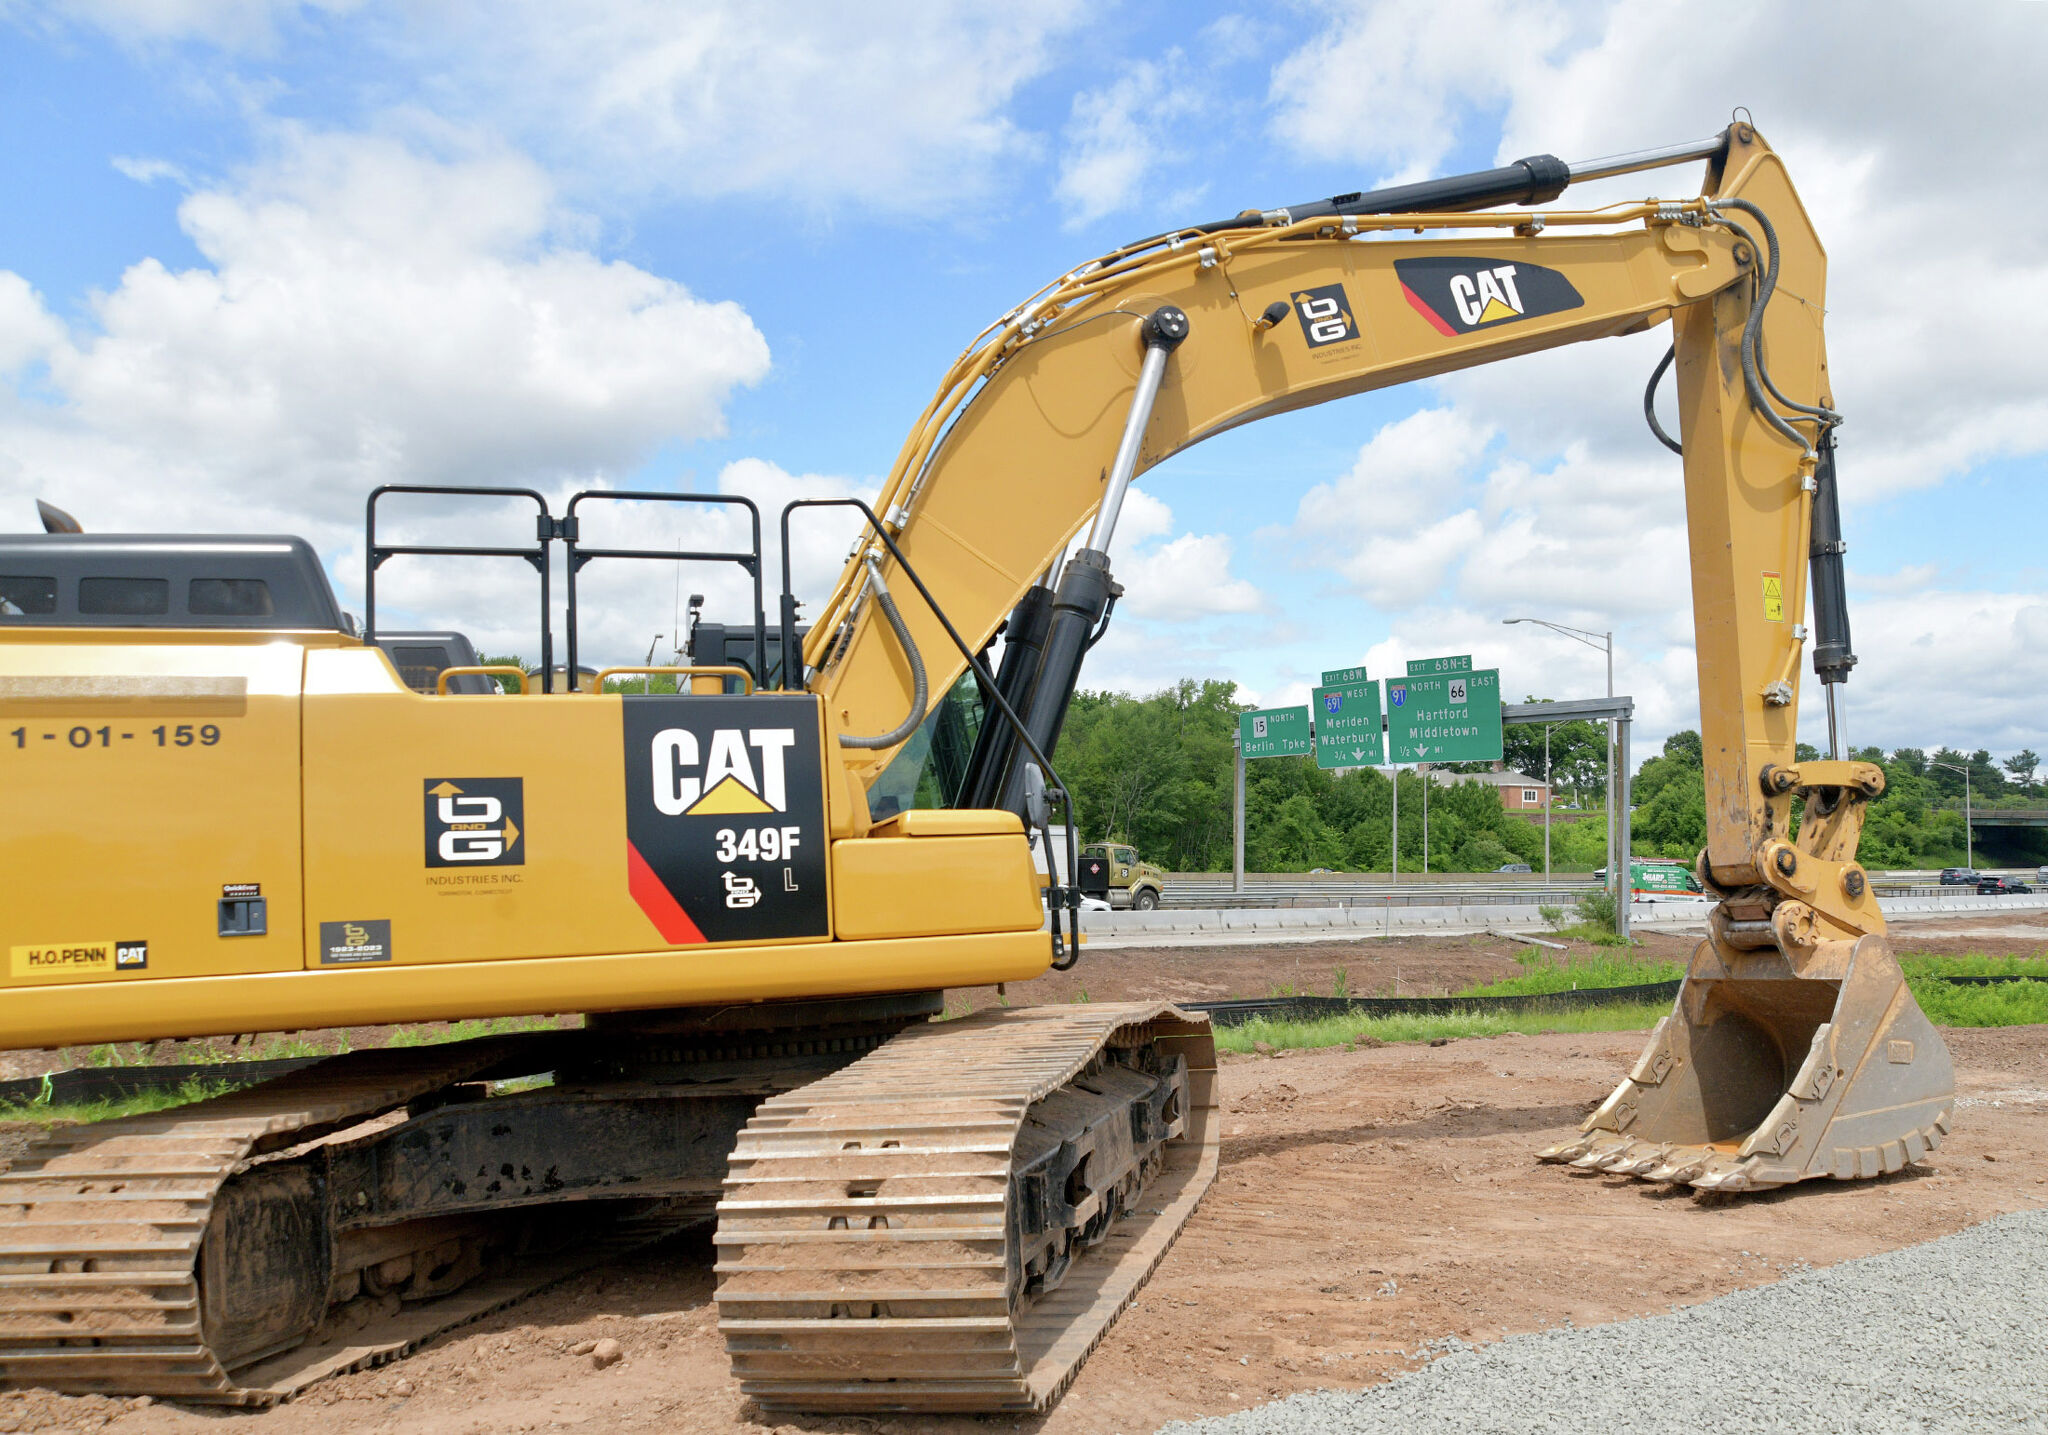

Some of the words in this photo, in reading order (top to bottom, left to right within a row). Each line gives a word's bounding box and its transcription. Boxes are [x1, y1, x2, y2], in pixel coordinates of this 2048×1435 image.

[1450, 265, 1524, 325] CAT
[1409, 663, 1425, 672] EXIT
[1435, 658, 1468, 671] 68N-E
[1325, 673, 1339, 682] EXIT
[1343, 669, 1362, 680] 68W
[1471, 676, 1494, 687] EAST
[1411, 681, 1440, 691] NORTH
[1451, 685, 1465, 698] 66
[1347, 688, 1368, 698] WEST
[1392, 690, 1404, 703] 91
[1327, 698, 1341, 710] 691
[1270, 713, 1295, 723] NORTH
[1417, 708, 1468, 721] Hartford
[1255, 721, 1265, 732] 15
[1326, 716, 1369, 729] Meriden
[1409, 726, 1478, 739] Middletown
[1246, 741, 1274, 752] Berlin
[1282, 739, 1305, 751] Tpke
[1321, 733, 1377, 746] Waterbury
[1334, 751, 1346, 760] 3/4
[1400, 746, 1410, 757] 1/2
[1434, 746, 1444, 754] MI
[652, 728, 796, 816] CAT
[451, 823, 486, 831] AND
[716, 827, 800, 863] 349F
[426, 875, 498, 885] INDUSTRIES
[501, 874, 524, 883] INC.
[784, 867, 799, 892] L
[117, 947, 146, 964] CAT
